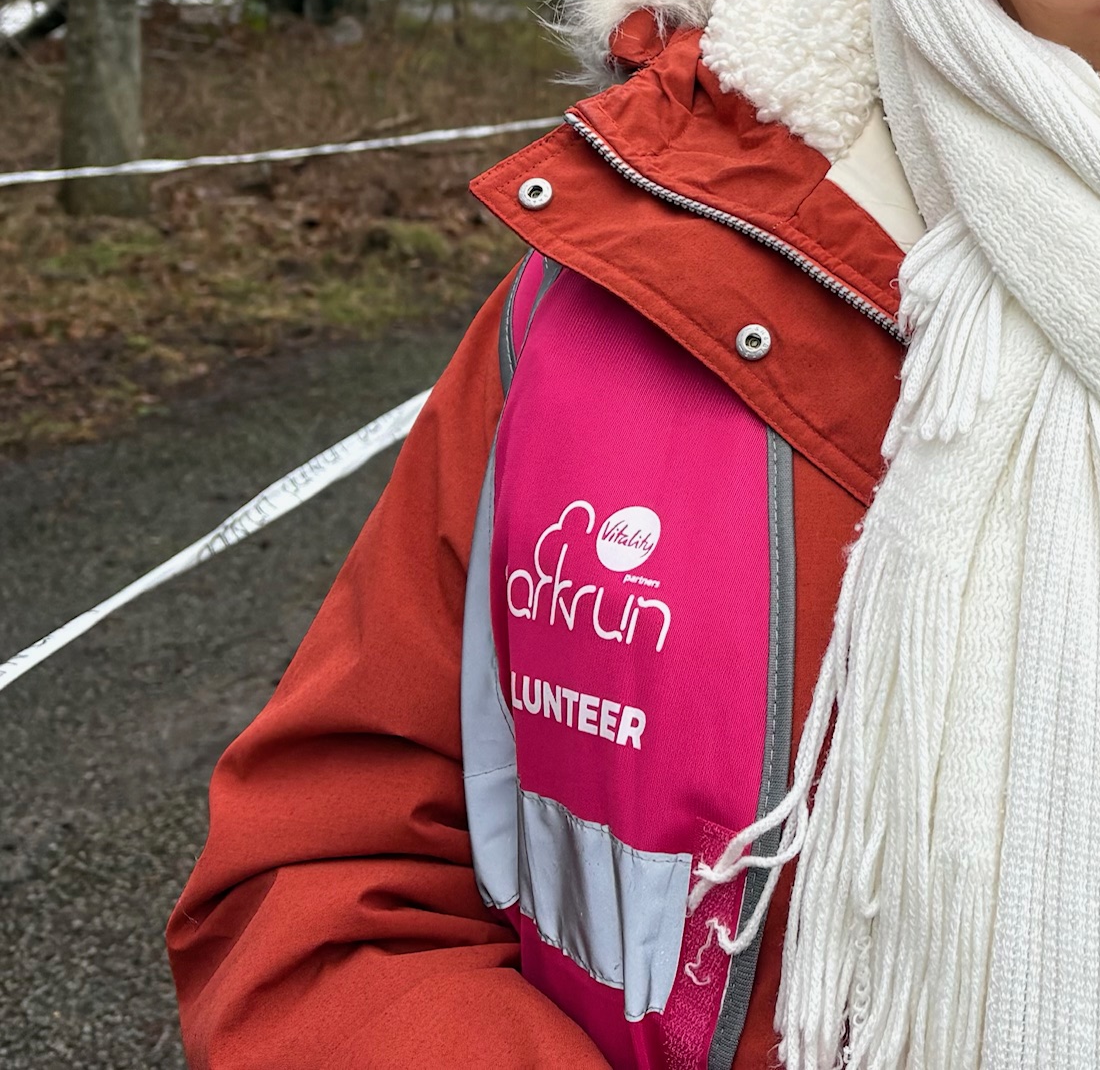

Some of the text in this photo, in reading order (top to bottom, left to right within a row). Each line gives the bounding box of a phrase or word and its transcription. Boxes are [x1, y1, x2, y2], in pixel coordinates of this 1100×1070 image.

[601, 519, 655, 558] Vitality
[505, 537, 671, 652] arkrun
[622, 573, 660, 588] partners
[510, 670, 647, 750] LUNTEER
